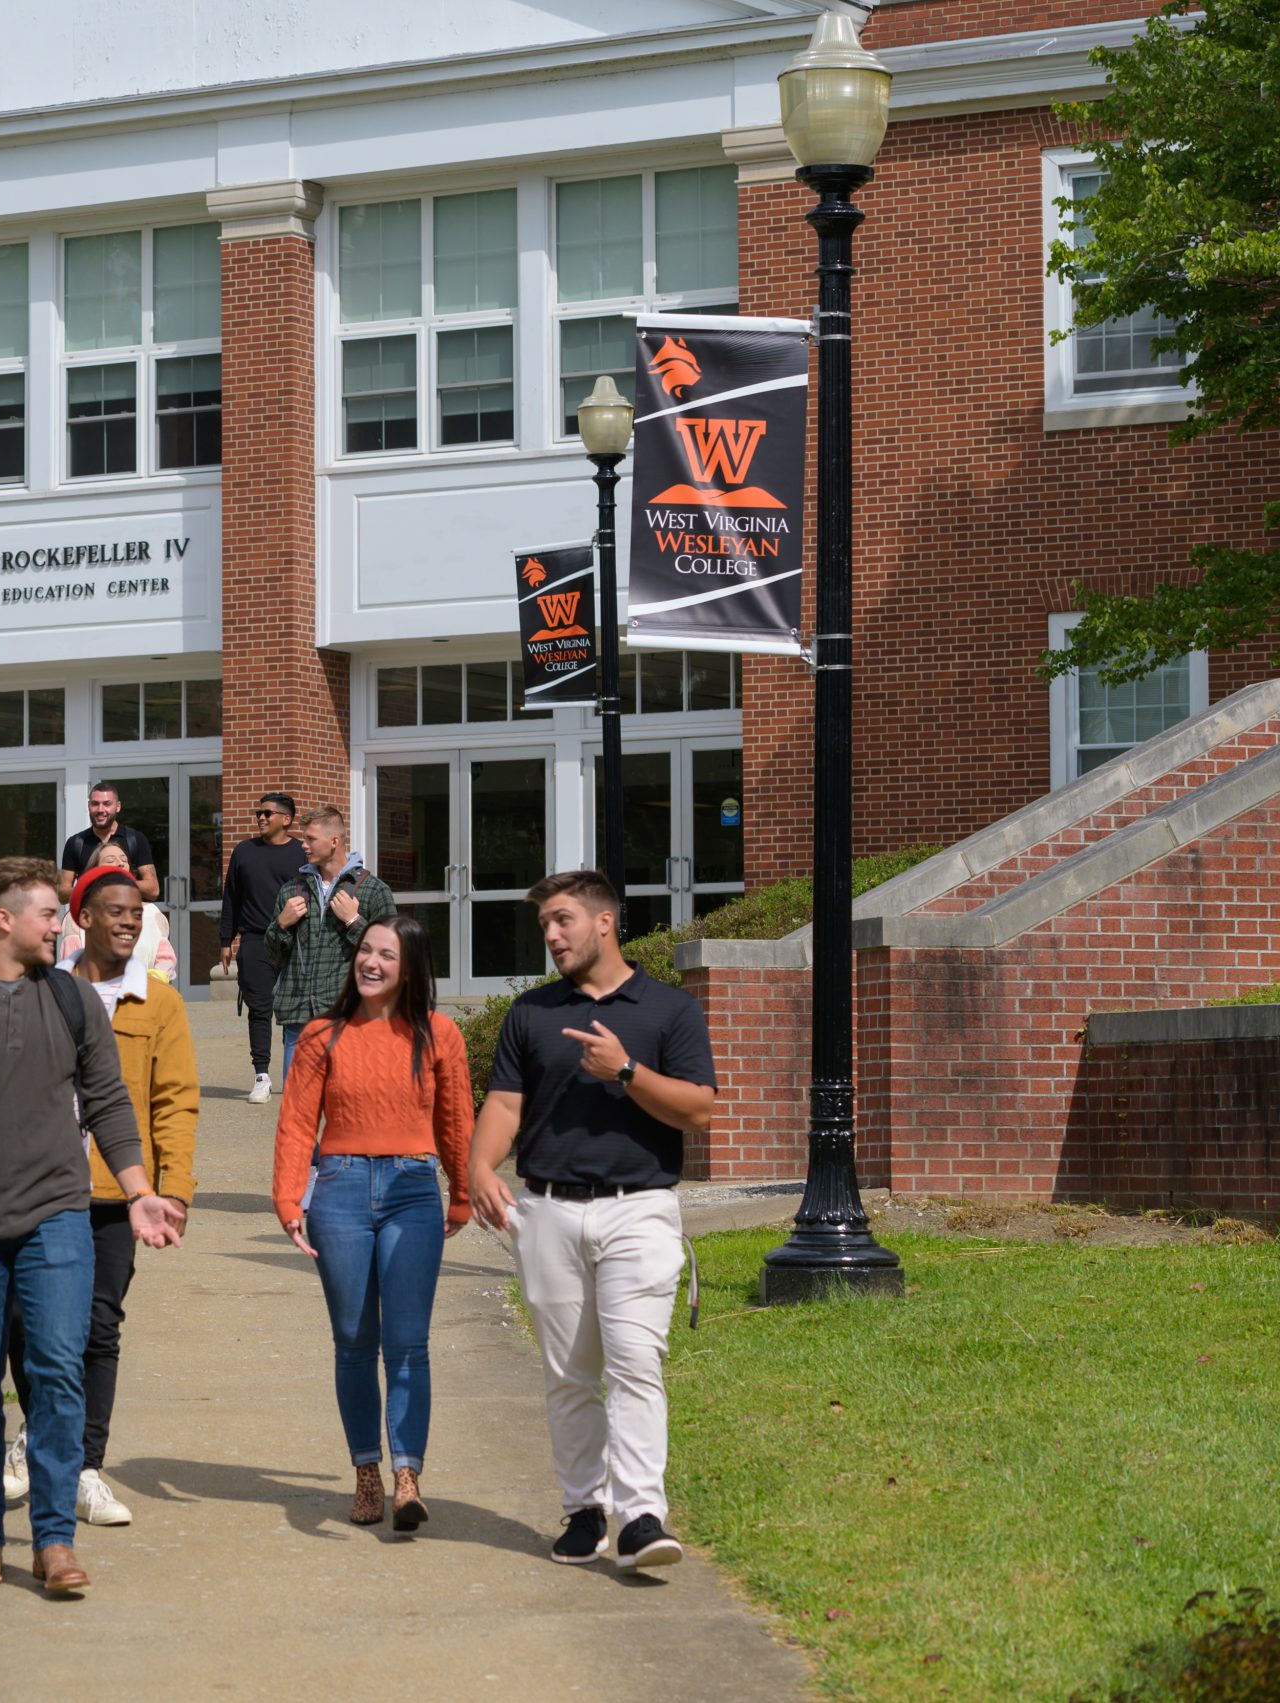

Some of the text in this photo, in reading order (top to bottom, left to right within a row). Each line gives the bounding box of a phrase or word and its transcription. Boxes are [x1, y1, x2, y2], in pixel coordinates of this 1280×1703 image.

[675, 417, 767, 484] W
[644, 509, 790, 533] WEST VIRGINIA
[1, 541, 151, 571] ROCKEFELLER
[165, 538, 190, 558] IV
[655, 530, 779, 557] WESLEYAN
[674, 554, 757, 576] COLLEGE
[2, 582, 96, 602] EDUCATION
[108, 578, 170, 595] CENTER
[537, 591, 580, 627] W
[528, 639, 591, 654] WEST VIRGINIA
[534, 650, 587, 664] WESLEYAN
[545, 661, 578, 672] COLLEGE
